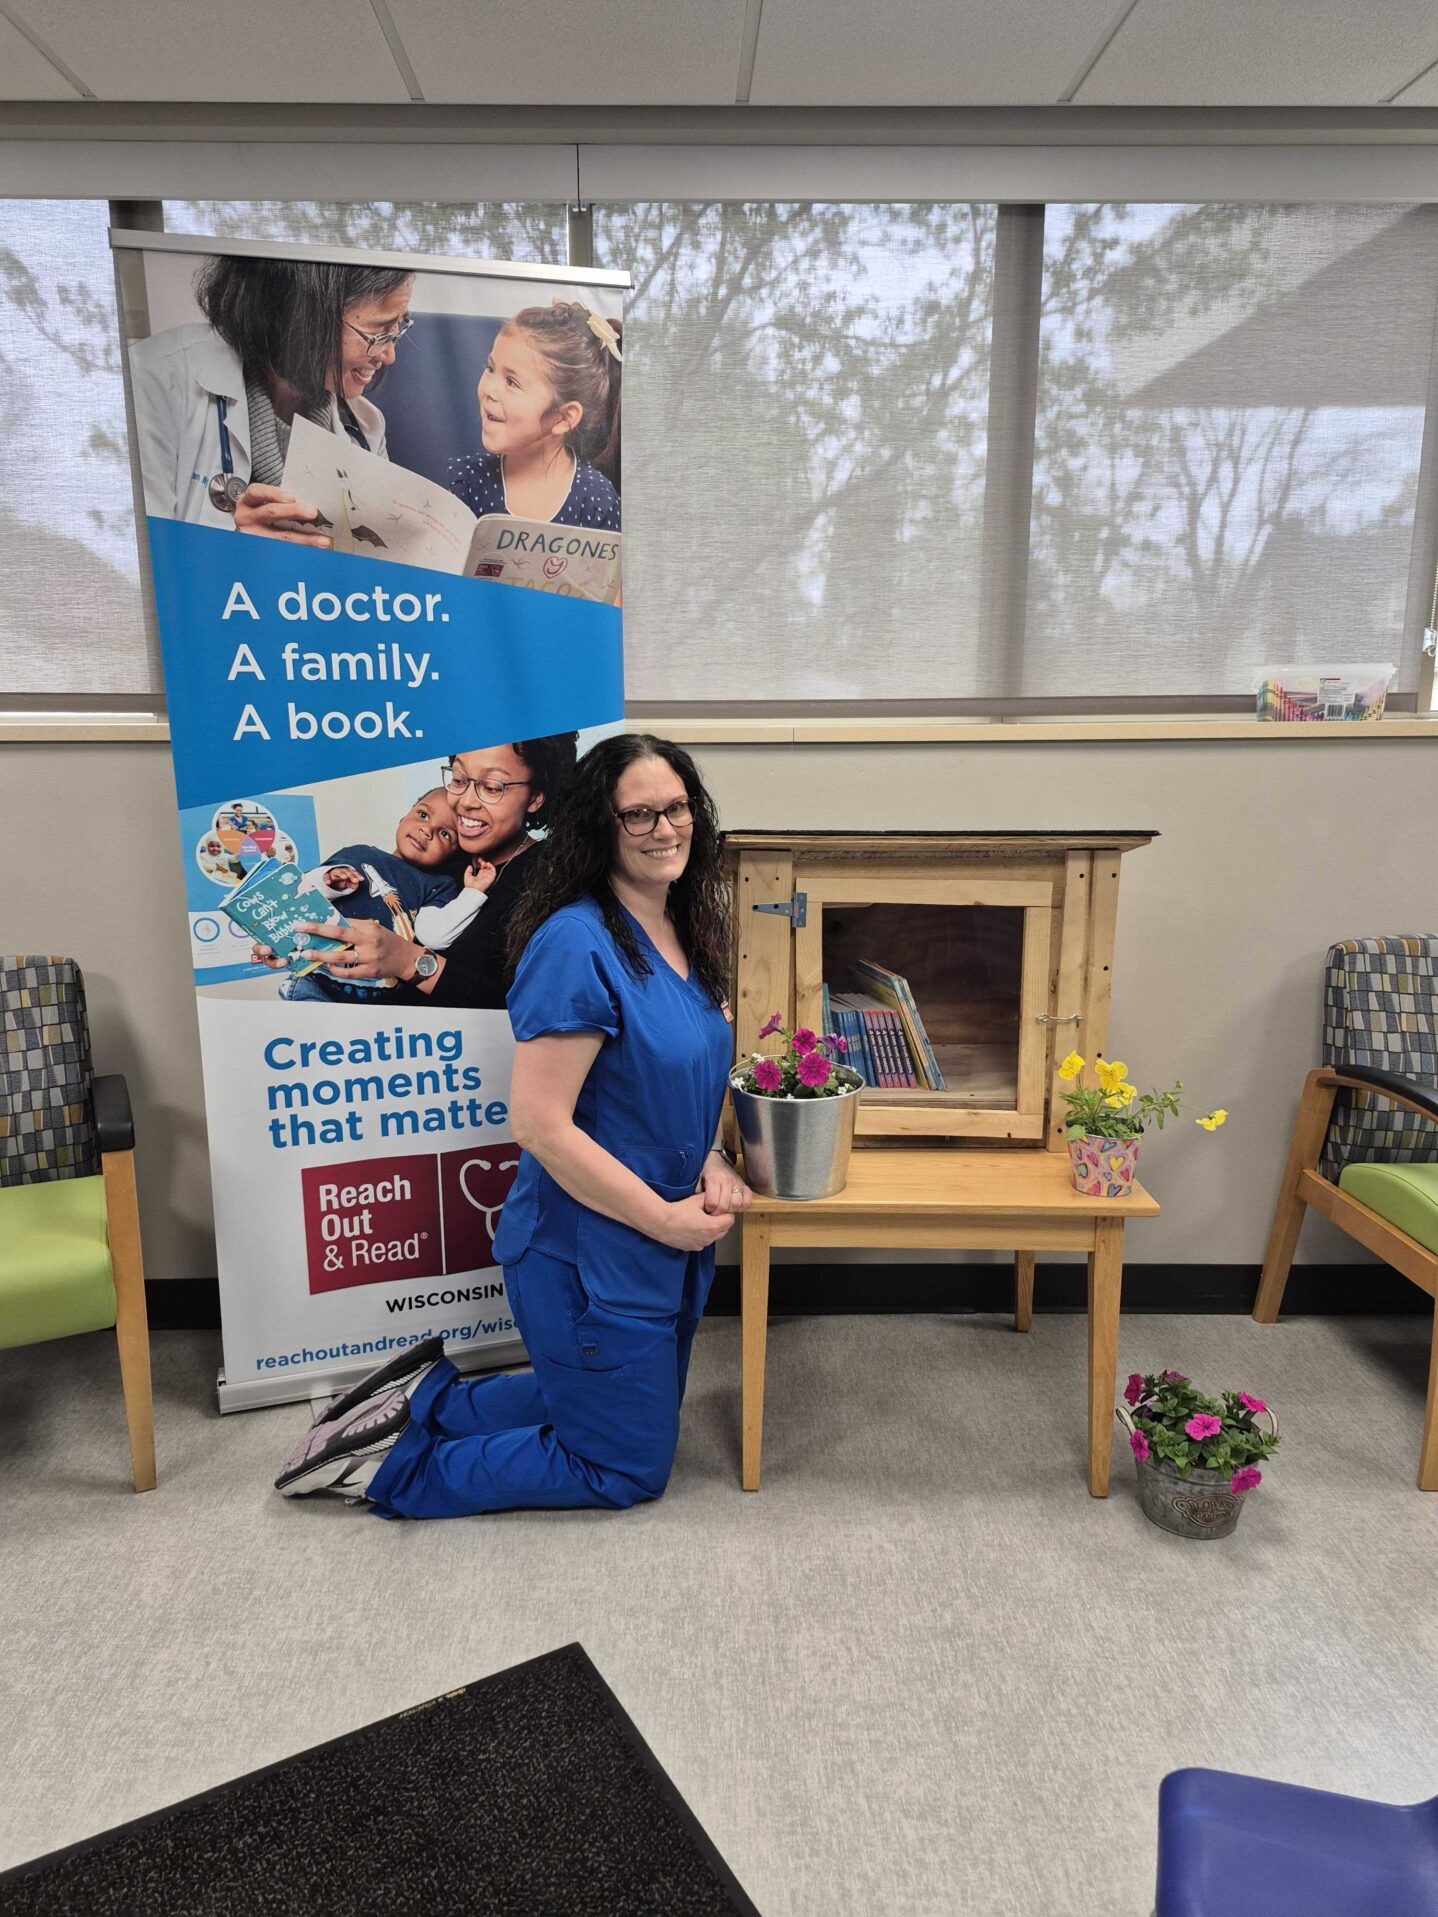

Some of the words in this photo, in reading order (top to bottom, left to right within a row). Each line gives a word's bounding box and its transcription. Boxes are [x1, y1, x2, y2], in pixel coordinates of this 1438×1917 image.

[496, 529, 620, 561] DRAGONES
[222, 582, 260, 619] A
[278, 582, 451, 622] doctor.
[228, 644, 265, 680] A
[282, 643, 439, 687] family.
[234, 704, 270, 740] A
[288, 702, 424, 740] book.
[236, 892, 265, 912] Cows
[261, 910, 289, 931] Blow
[263, 1027, 464, 1070] Creating
[267, 1063, 482, 1110] moments
[269, 1111, 364, 1149] that
[380, 1098, 508, 1137] matte
[319, 1174, 412, 1212] Reach
[321, 1209, 373, 1242] Out
[323, 1245, 344, 1272] &
[386, 1283, 504, 1313] WISCONSIN
